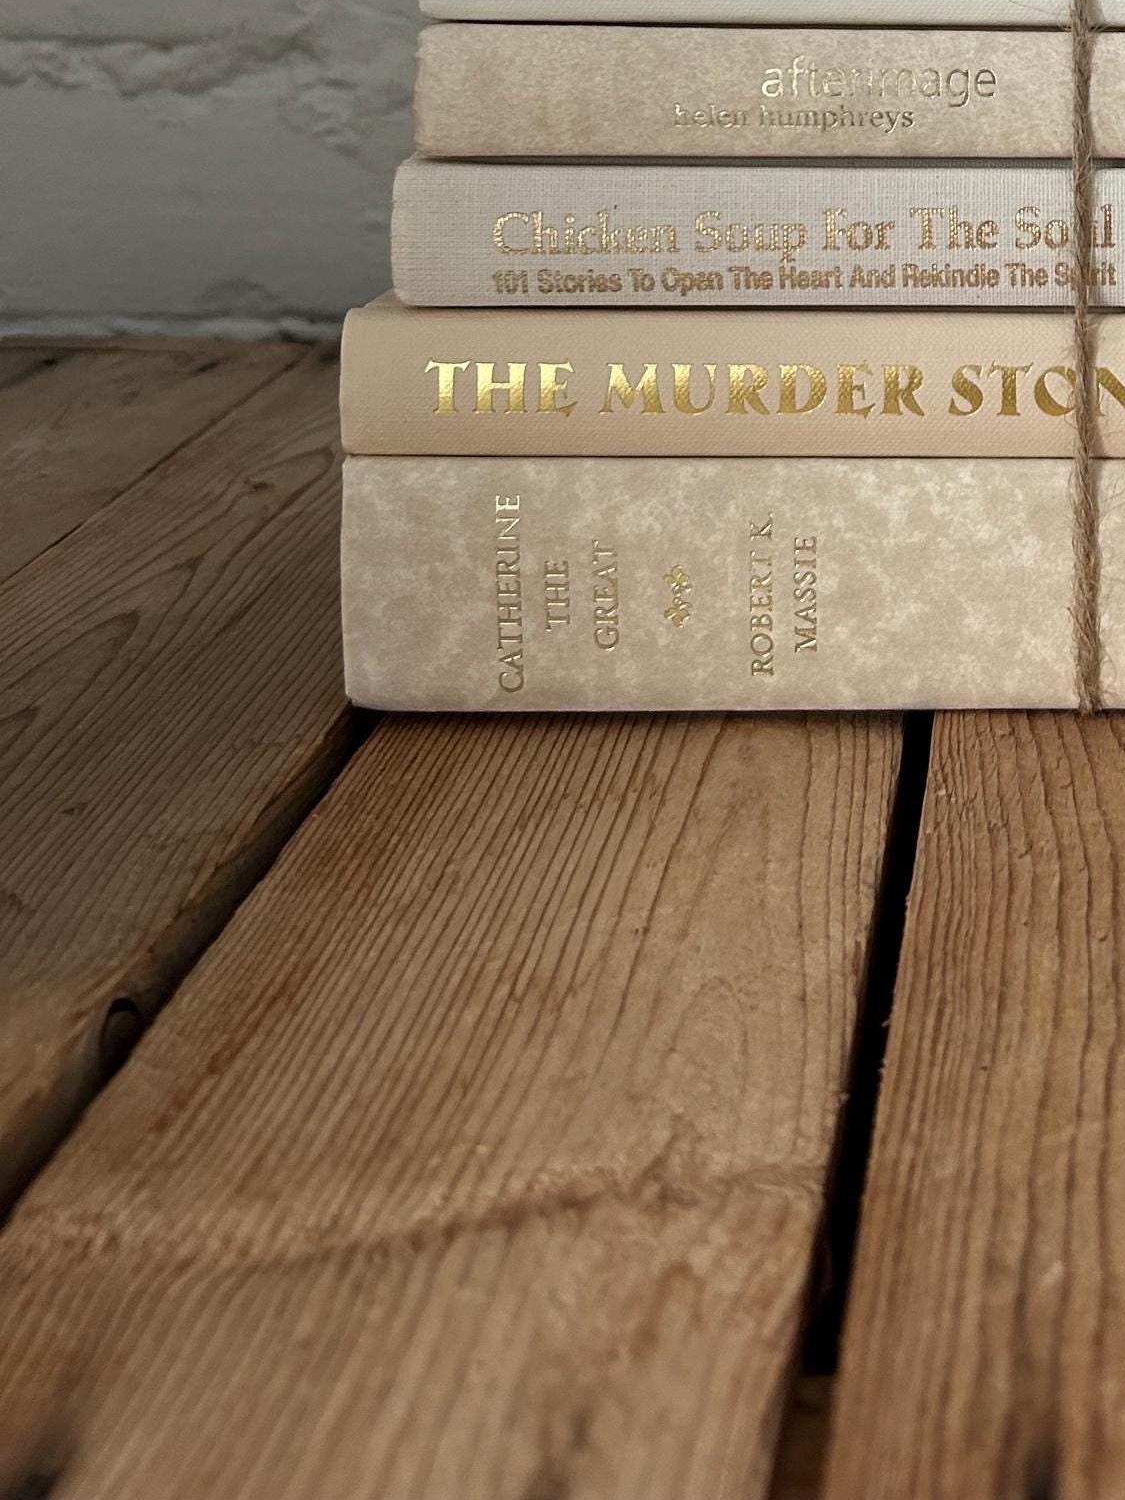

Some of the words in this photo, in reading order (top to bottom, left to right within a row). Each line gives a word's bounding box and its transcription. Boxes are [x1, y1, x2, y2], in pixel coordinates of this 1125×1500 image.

[760, 56, 998, 108] afterimage
[673, 104, 750, 128] helen
[758, 105, 916, 133] humphreys
[492, 209, 680, 255] Chicken
[694, 209, 808, 263] Soup
[822, 207, 895, 252] For
[910, 205, 999, 251] The
[536, 268, 623, 293] Stories
[627, 267, 655, 292] To
[661, 266, 724, 296] Open
[729, 265, 774, 290] The
[779, 266, 843, 290] Heart
[849, 264, 896, 288] And
[901, 263, 1000, 289] Rekindle
[1004, 262, 1049, 288] The
[424, 359, 579, 417] THE
[598, 360, 926, 418] MURDER
[496, 495, 525, 693] CATHERINE
[544, 560, 571, 632] THE
[593, 539, 620, 651] GREAT
[750, 550, 774, 677] ROBERT
[793, 536, 818, 653] MASSIE
